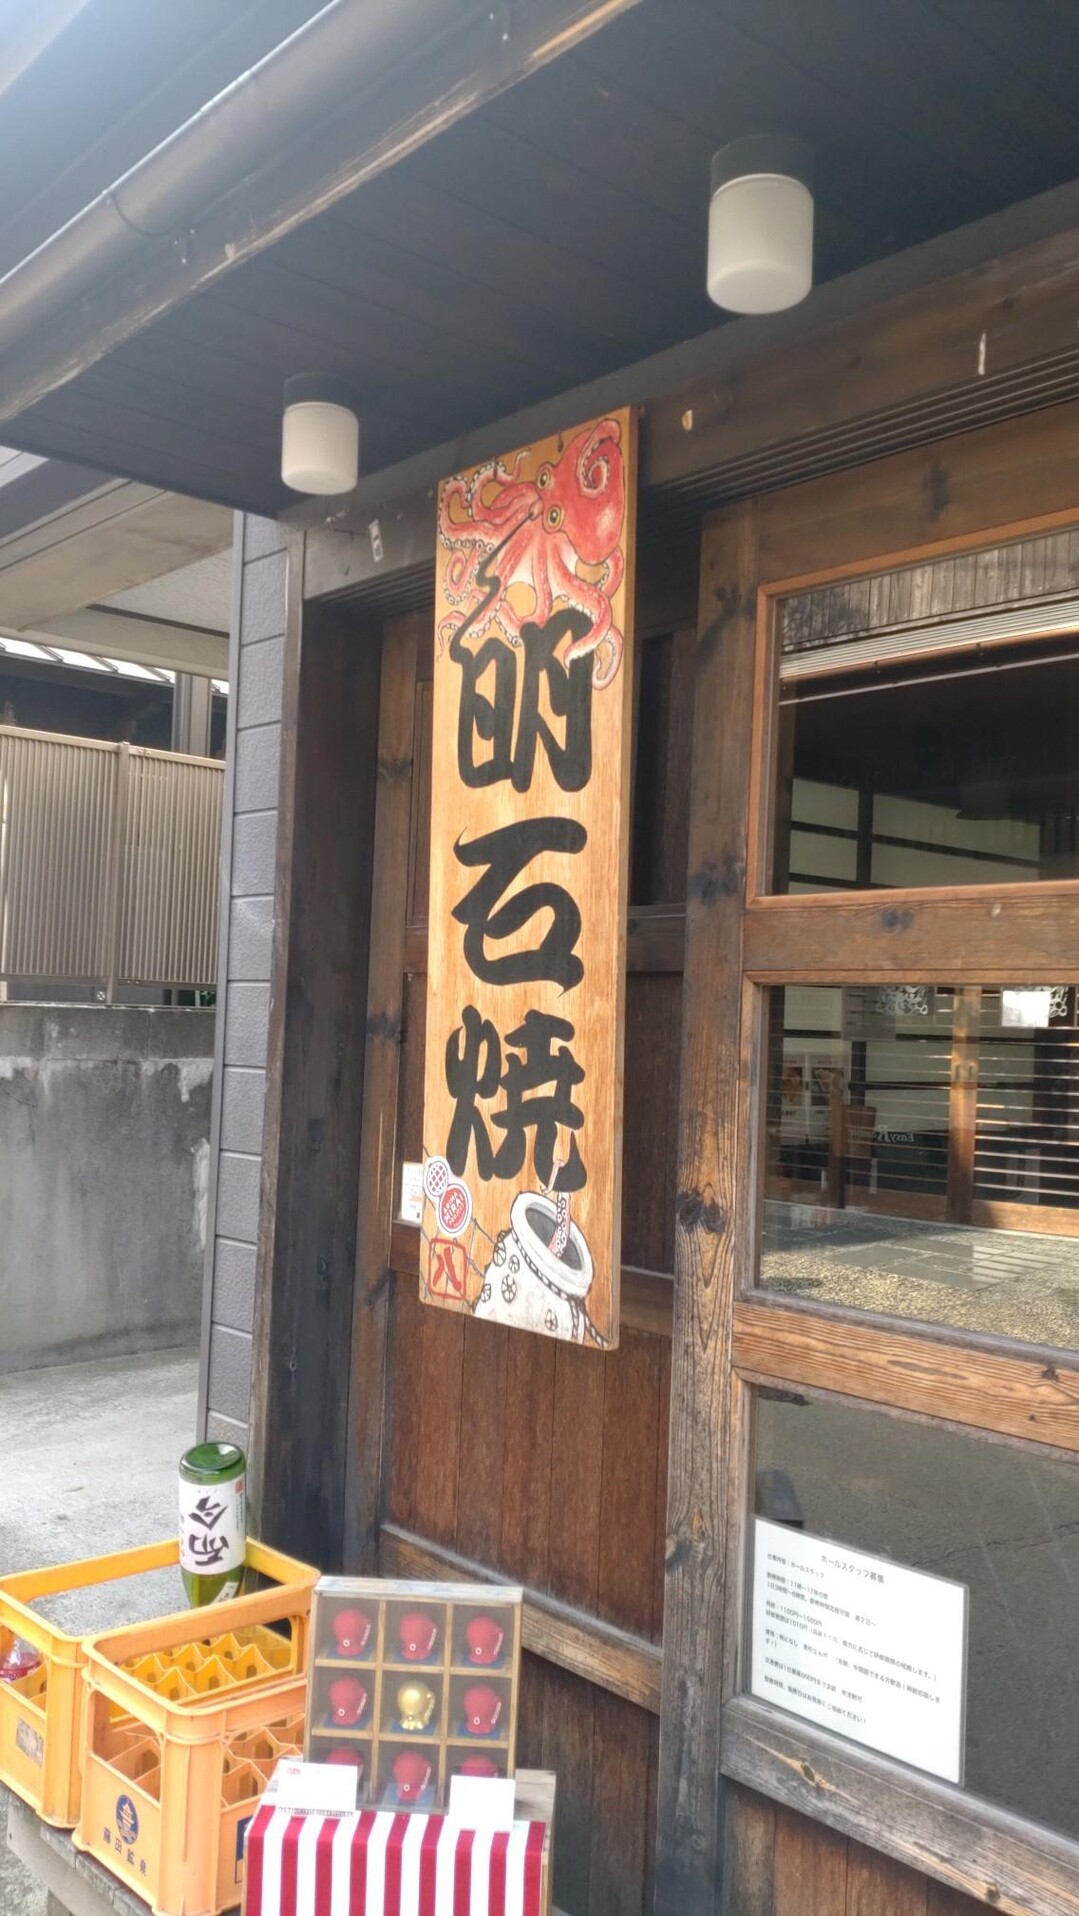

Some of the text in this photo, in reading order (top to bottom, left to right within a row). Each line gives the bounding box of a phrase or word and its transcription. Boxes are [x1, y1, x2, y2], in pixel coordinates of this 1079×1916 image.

[445, 607, 593, 1192] 明石焼
[188, 1496, 229, 1567] 而今
[821, 1555, 885, 1583] ホールスタッフ募集
